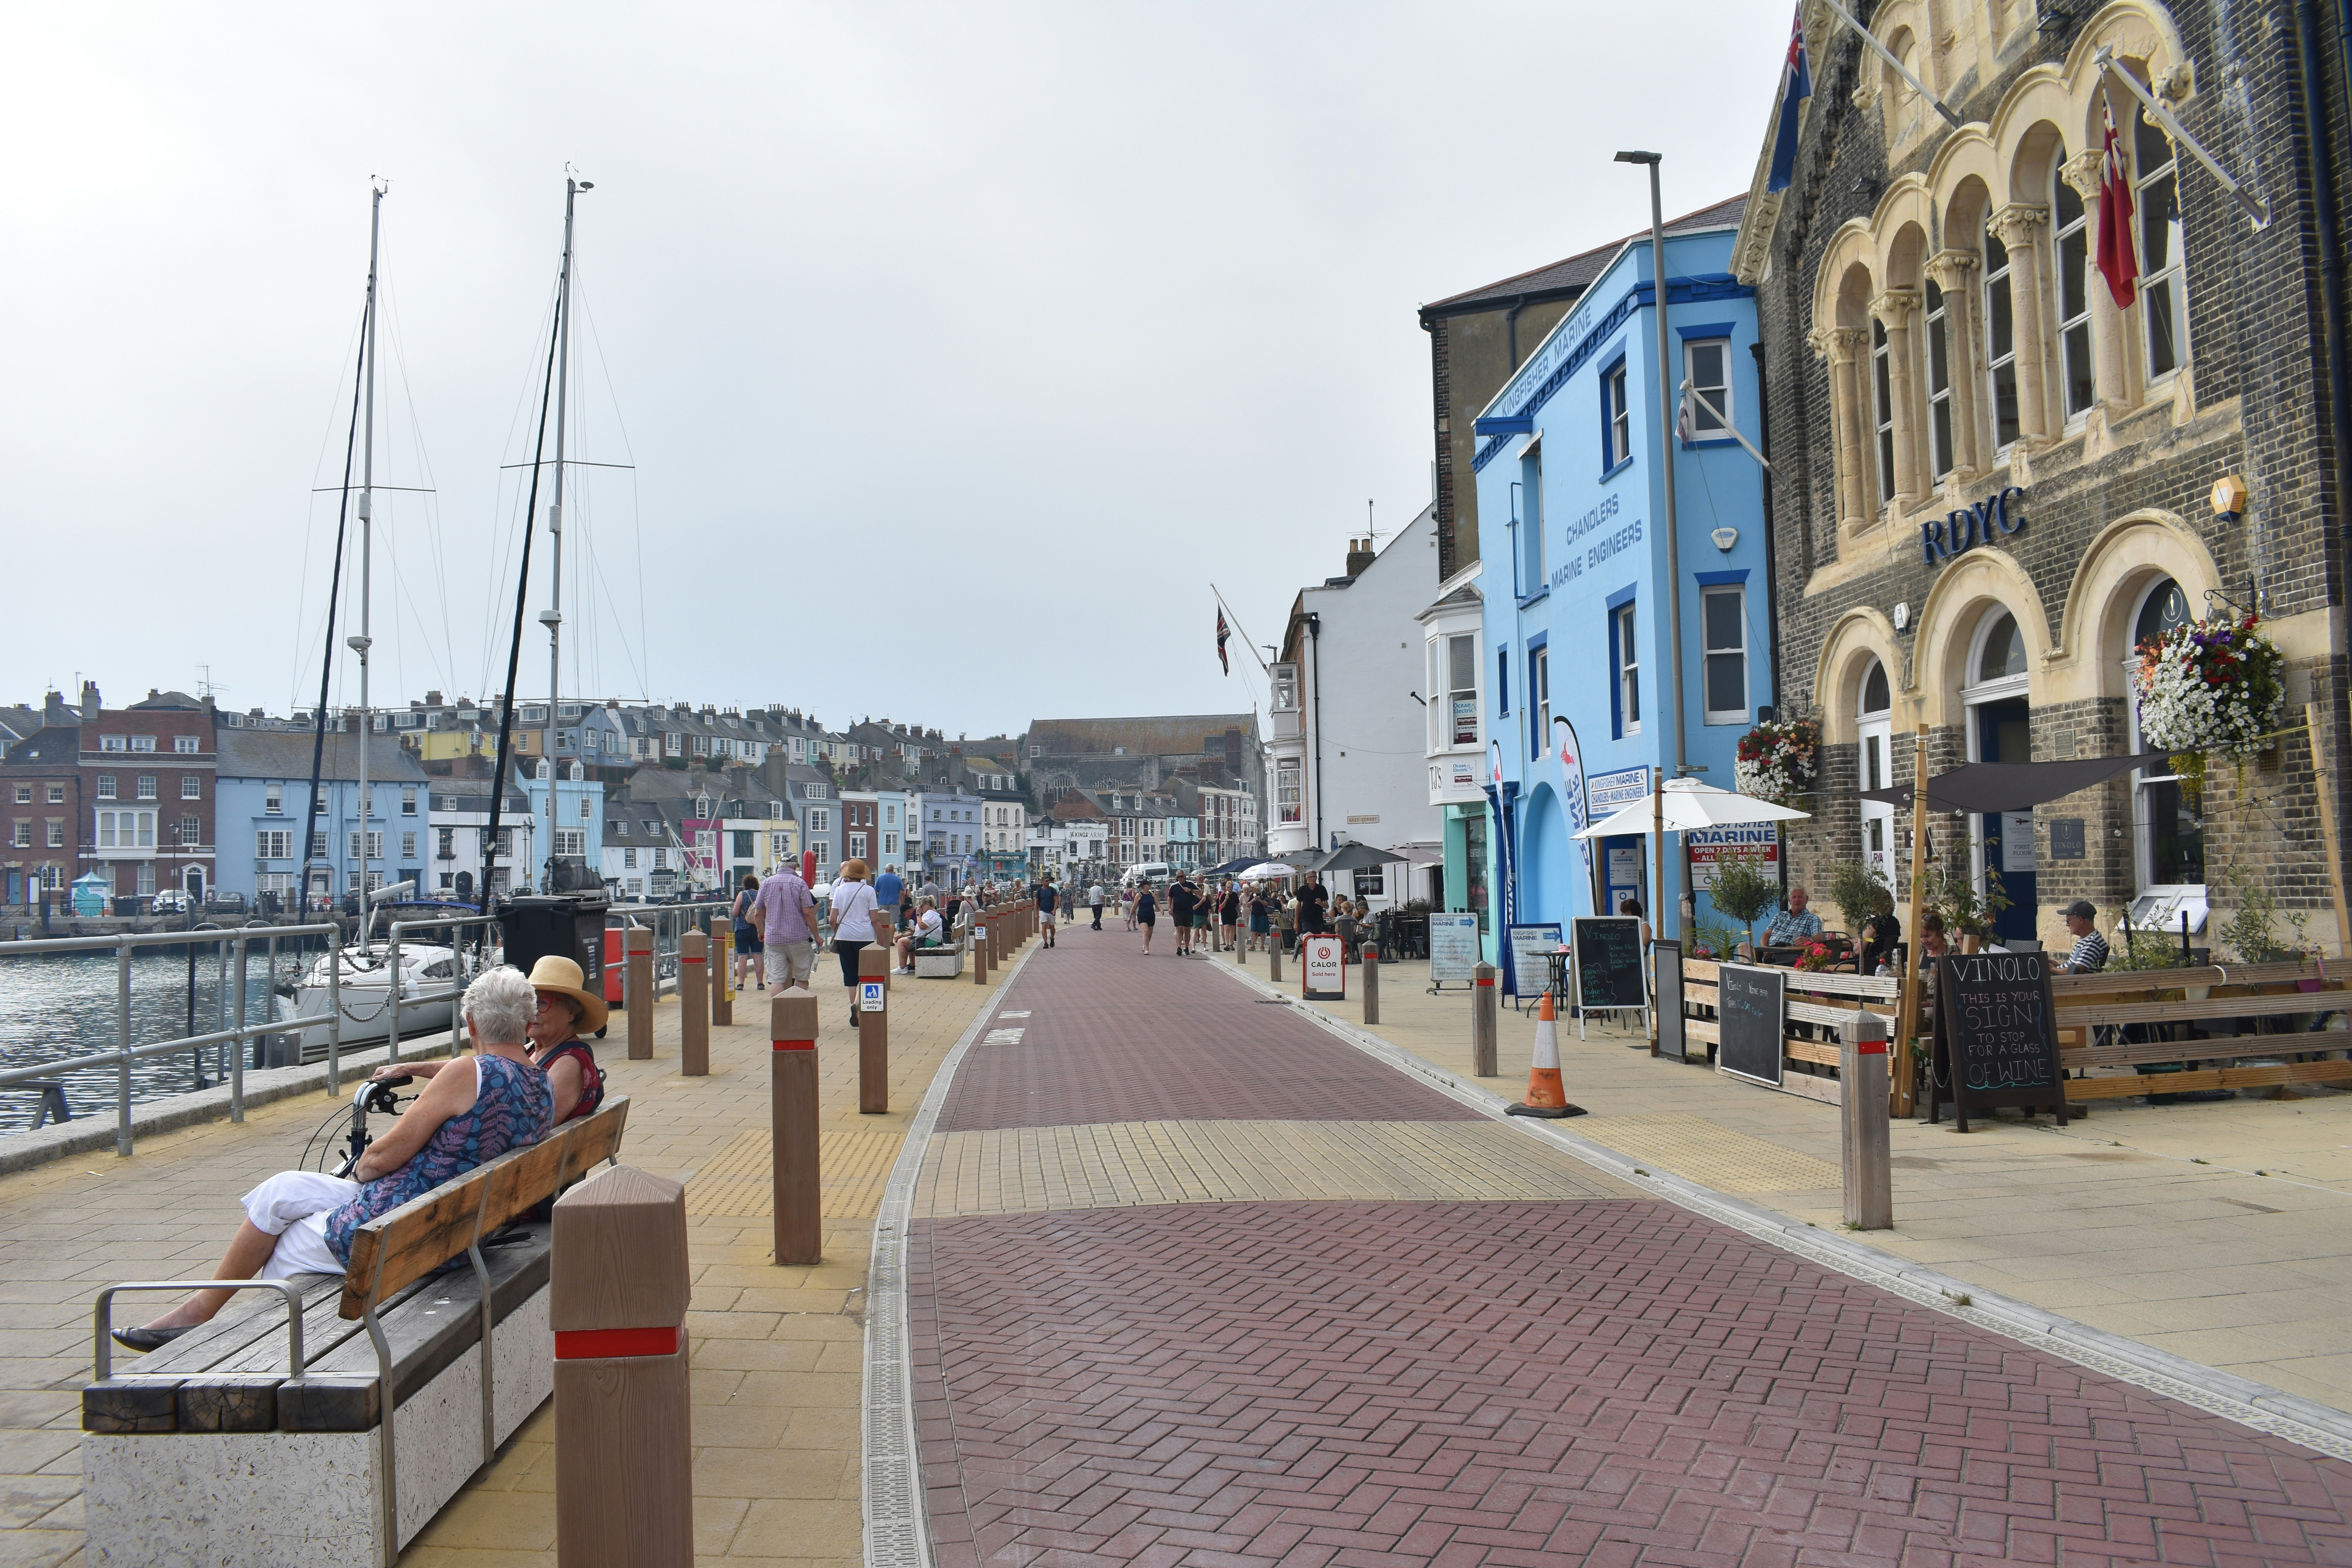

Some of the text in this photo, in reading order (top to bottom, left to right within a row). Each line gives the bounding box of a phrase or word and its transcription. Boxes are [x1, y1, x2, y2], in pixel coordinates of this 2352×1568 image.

[1502, 305, 1592, 417] KINGFISHER MARINE
[1567, 493, 1619, 546] CHANDLERS
[1920, 486, 2025, 564] RDYC
[1552, 520, 1642, 591] MARINE ENGINEERS
[1594, 772, 1639, 789] KINGFISHER MARINE
[1592, 786, 1644, 804] CHANDLERS MARINE ENGINEERS
[1690, 830, 1775, 843] MARINE
[1582, 925, 1620, 940] VINOLO
[1952, 958, 2040, 981] VINOLO
[1584, 987, 1605, 997] Fridays
[1960, 991, 2040, 1004] THIS IS YOUR
[1966, 1004, 2032, 1029] SIGN
[1976, 1031, 2025, 1044] TO STOP
[1968, 1043, 2040, 1056] FOR A GLASS
[1969, 1059, 2051, 1083] OF WINE
